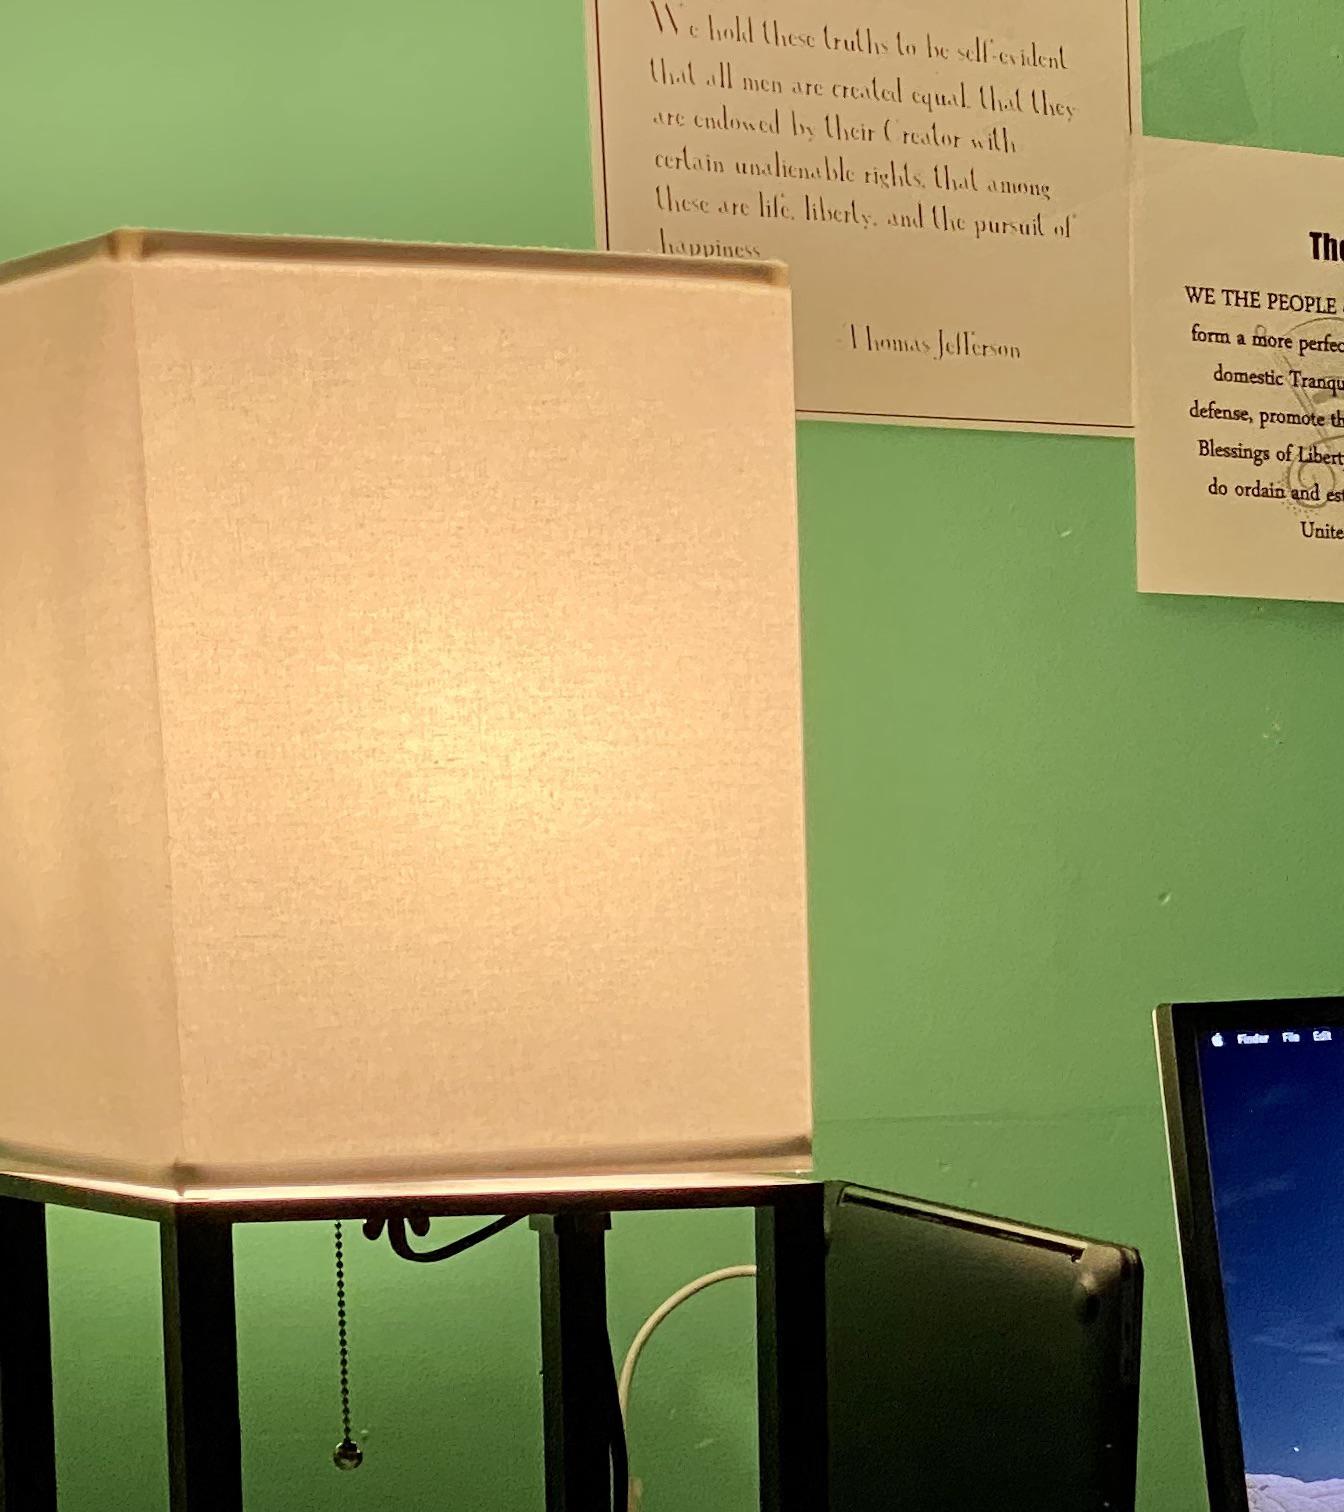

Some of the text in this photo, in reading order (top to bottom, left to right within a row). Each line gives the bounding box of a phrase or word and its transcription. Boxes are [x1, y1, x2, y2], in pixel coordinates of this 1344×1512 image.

[1184, 285, 1216, 305] WE
[1220, 288, 1261, 309] THE
[1266, 292, 1340, 316] PEOPLE
[1191, 323, 1231, 344] form
[1236, 333, 1246, 345] a
[1252, 335, 1293, 349] more
[1213, 362, 1284, 386] domestic
[1189, 399, 1253, 424] defense,
[1258, 411, 1325, 429] promote
[1198, 438, 1270, 467] Blessings
[1275, 443, 1294, 462] of
[1208, 476, 1227, 496] do
[1234, 479, 1286, 499] ordain
[1290, 482, 1320, 501] and
[1282, 1032, 1301, 1043] File
[1313, 1031, 1332, 1042] Edit
